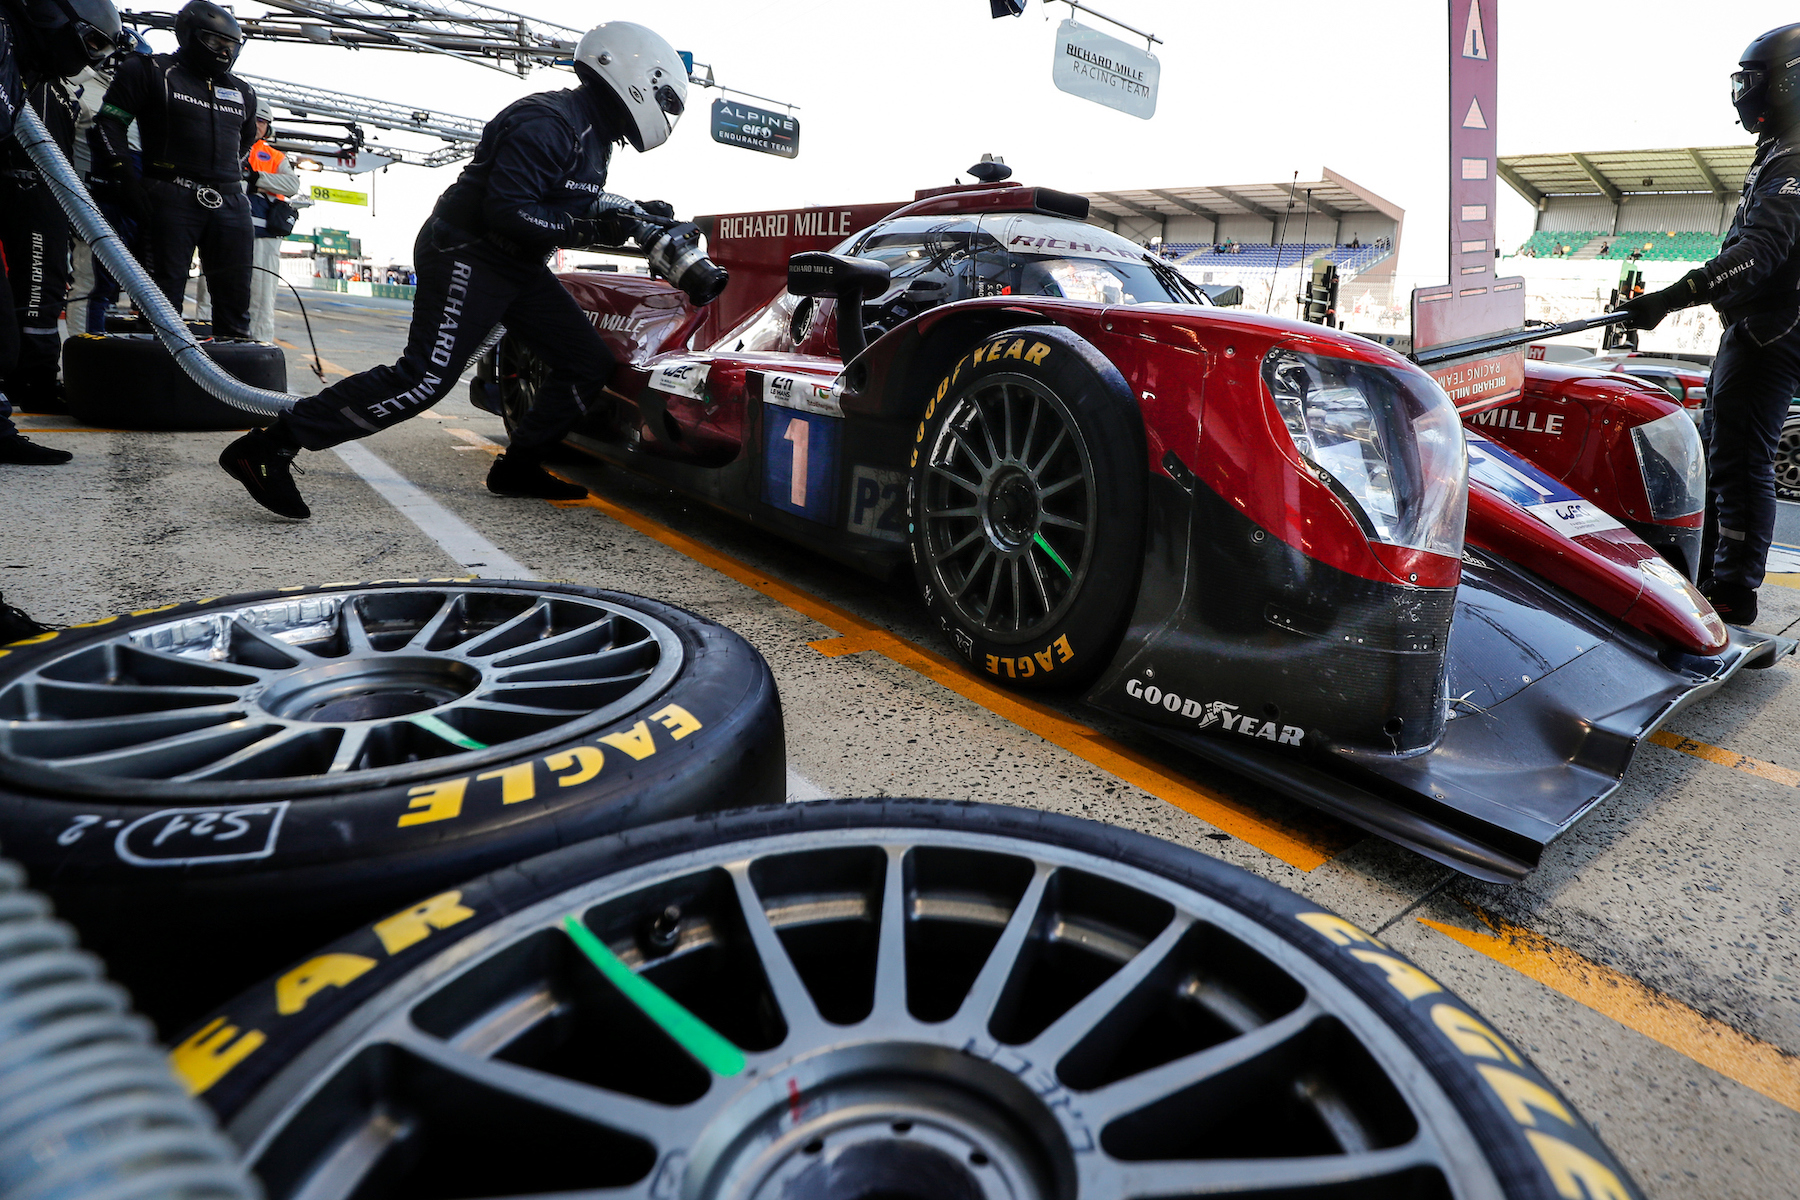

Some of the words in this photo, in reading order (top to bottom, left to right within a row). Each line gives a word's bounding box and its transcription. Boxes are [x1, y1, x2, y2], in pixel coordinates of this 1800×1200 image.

[1066, 43, 1112, 70] RICHARD
[1115, 62, 1144, 82] MILLE
[1073, 61, 1117, 87] RACING
[1120, 78, 1150, 99] TEAM
[219, 104, 244, 116] MILLE
[720, 106, 794, 131] ALPINE
[719, 131, 768, 148] ENDURANCE
[771, 142, 793, 153] TEAM
[742, 124, 761, 136] elf
[313, 188, 330, 199] 98
[720, 214, 788, 239] RICHARD
[794, 211, 852, 237] MILLE
[31, 232, 43, 282] RICHARD
[789, 264, 812, 274] RICHARD
[813, 264, 834, 274] MILLE
[1729, 257, 1756, 278] MILLE
[430, 260, 473, 368] RICHARD
[599, 313, 647, 333] MILLE
[1528, 347, 1545, 359] HY
[663, 366, 693, 380] WEC
[1437, 372, 1464, 388] TEAM
[1467, 362, 1501, 382] RACING
[367, 371, 443, 418] MILLE
[1471, 376, 1507, 395] RICHARD
[1472, 408, 1565, 435] MILLE
[783, 418, 809, 507] 1
[852, 476, 903, 531] P2
[985, 633, 1074, 678] EAGLE
[396, 703, 703, 828] EAGLE
[1295, 911, 1633, 1200] EAGLE
